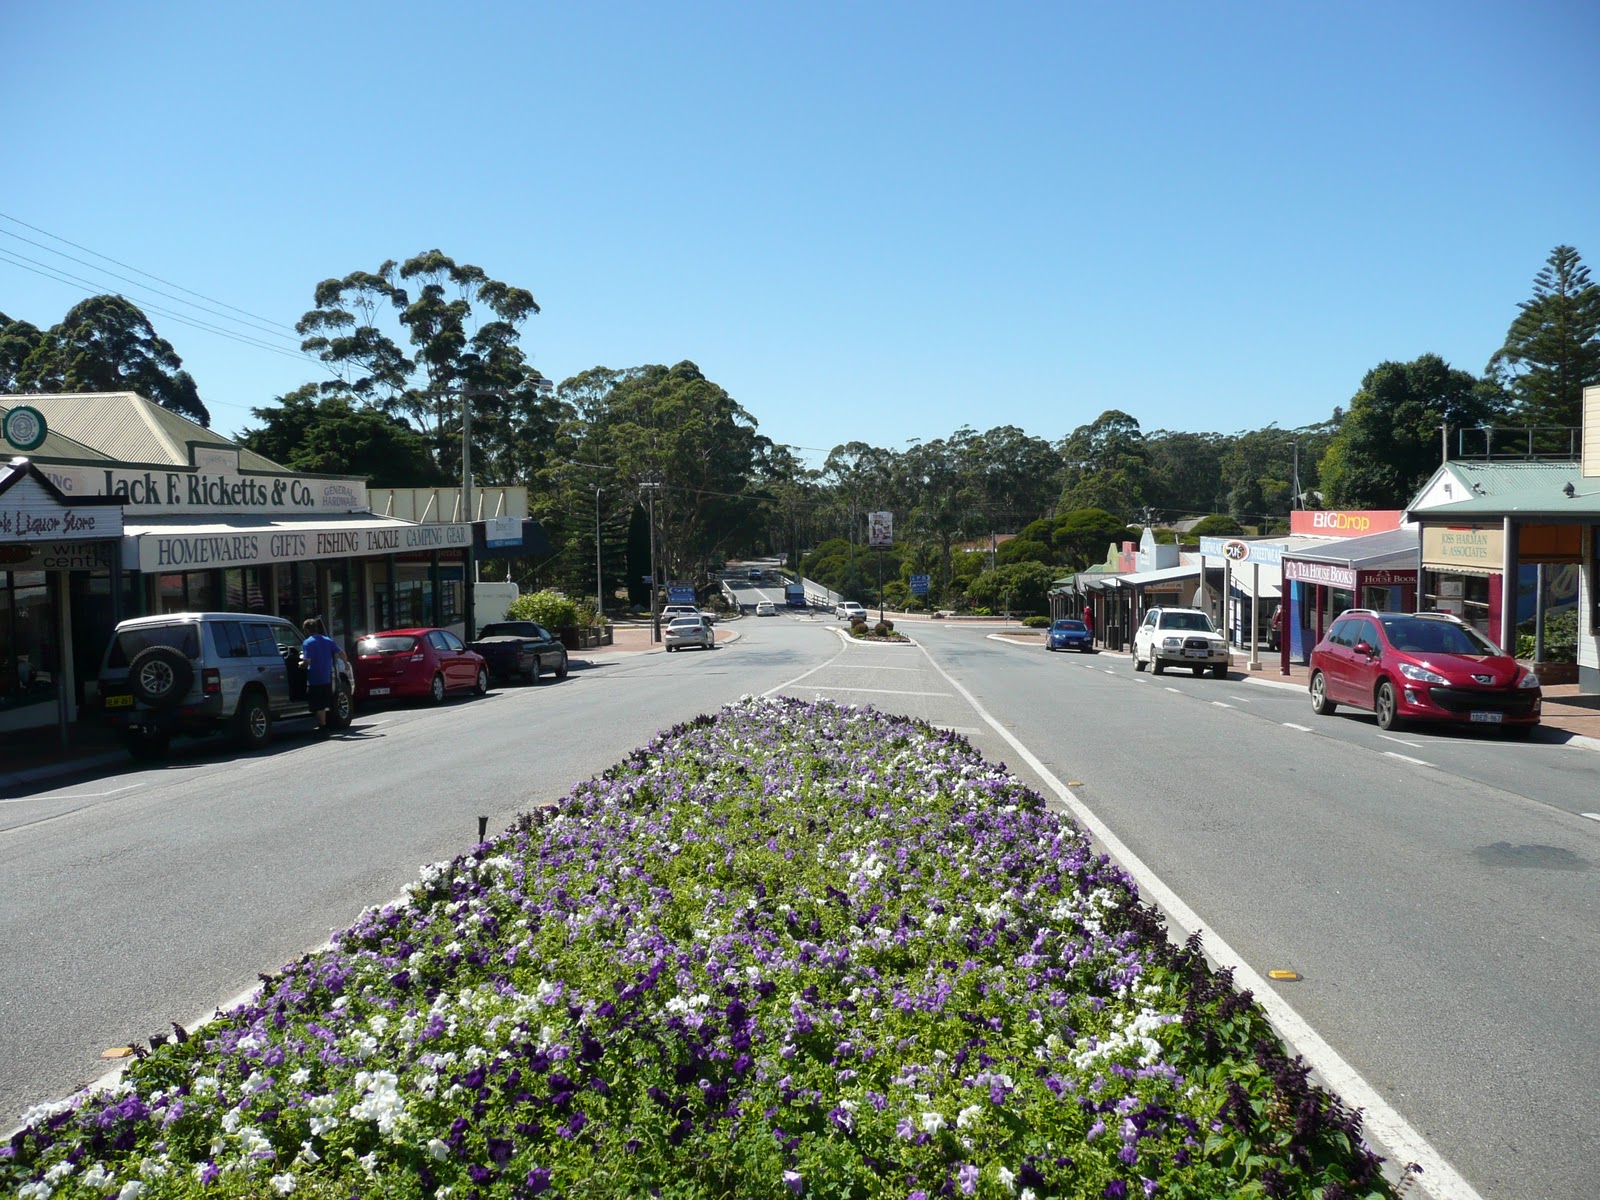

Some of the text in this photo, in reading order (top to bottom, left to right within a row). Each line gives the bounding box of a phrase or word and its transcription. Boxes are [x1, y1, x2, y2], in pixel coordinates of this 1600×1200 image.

[98, 470, 315, 507] Jack F. Ricketts & Co.
[323, 485, 353, 496] GENERAL
[322, 495, 358, 507] HARDWARE
[15, 510, 60, 536] Liquor
[62, 510, 96, 534] Store
[157, 527, 466, 566] HOMEWARES GIFTS FISHING TACKLE CAMPING GEAR
[1441, 533, 1488, 545] JOSS HARMAN
[1449, 546, 1488, 558] ASSOCIATES
[1297, 562, 1354, 585] TEA HOUSE BOOKS
